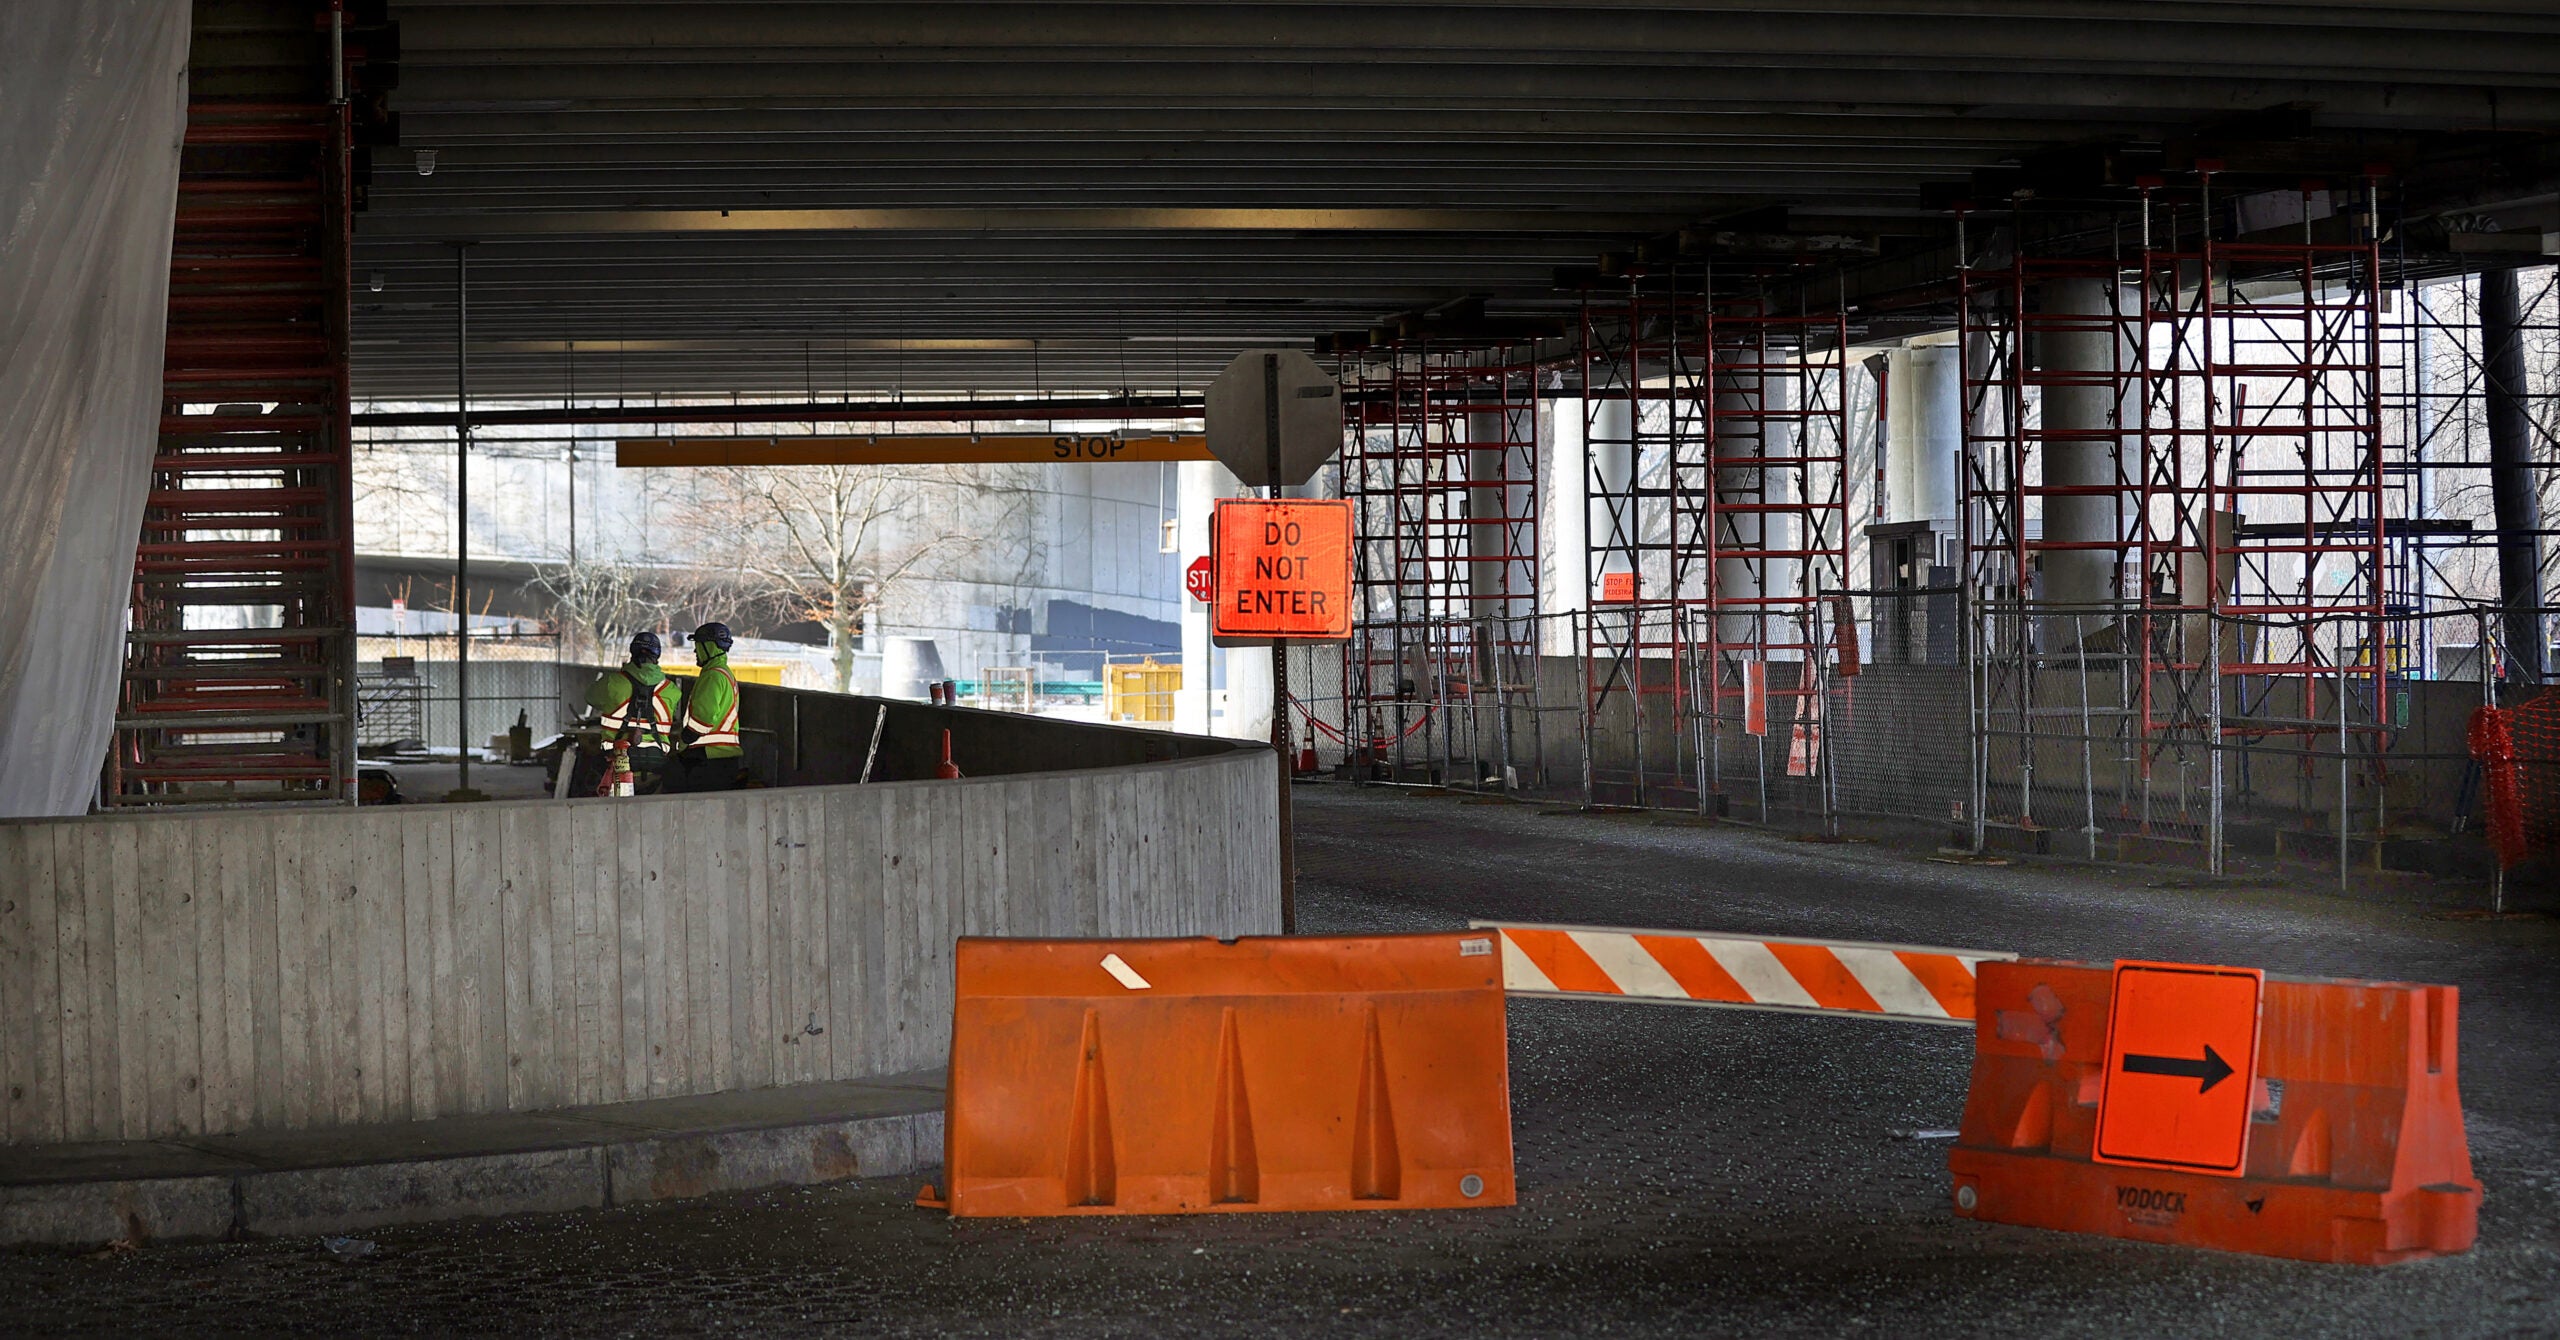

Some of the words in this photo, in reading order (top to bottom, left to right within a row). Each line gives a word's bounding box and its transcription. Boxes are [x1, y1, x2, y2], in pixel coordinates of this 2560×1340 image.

[1054, 436, 1126, 458] STOP
[1264, 521, 1301, 546] DO
[1189, 569, 1212, 588] ST
[1256, 555, 1309, 581] NOT
[1605, 577, 1624, 587] STOP
[1237, 589, 1327, 615] ENTER
[2116, 1185, 2187, 1214] YODOCK
